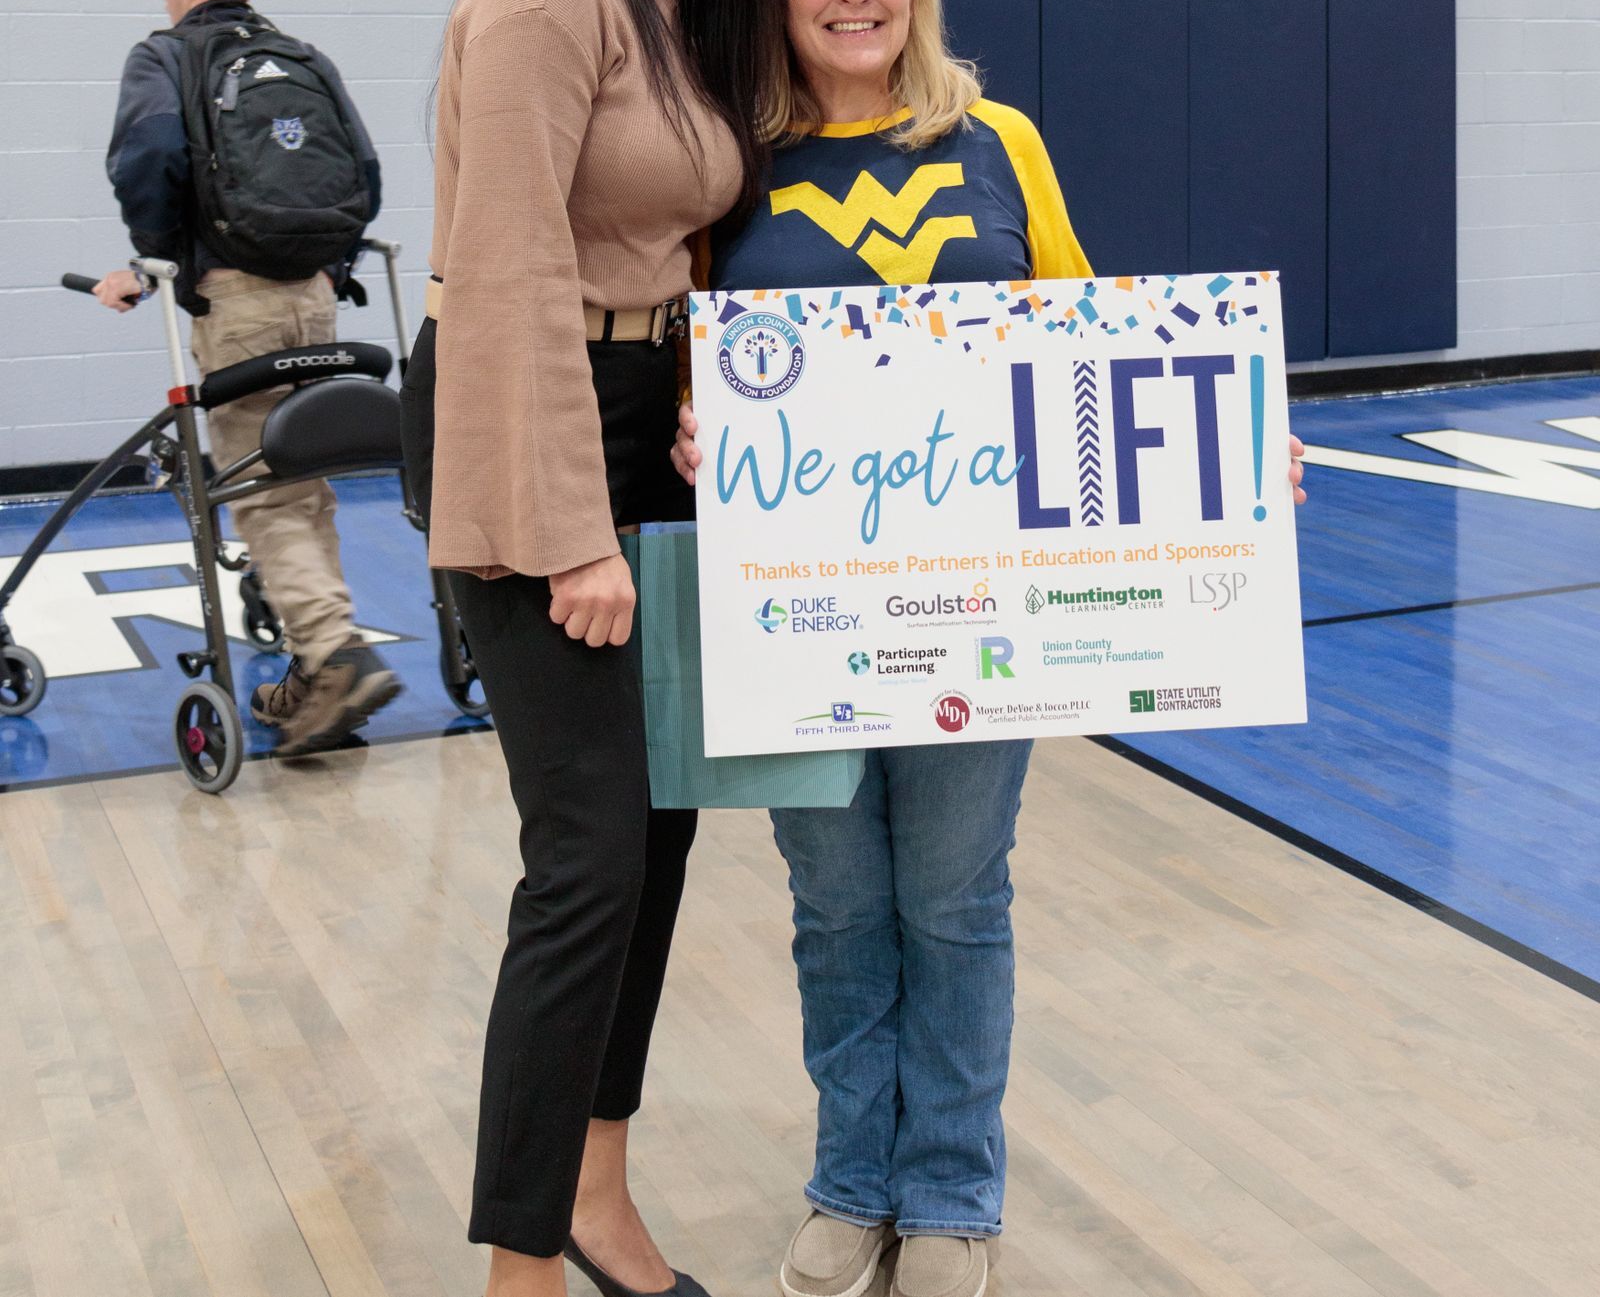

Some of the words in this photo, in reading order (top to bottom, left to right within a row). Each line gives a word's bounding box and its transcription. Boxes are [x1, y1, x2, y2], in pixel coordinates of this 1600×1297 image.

[726, 317, 754, 340] UNION
[757, 316, 795, 337] COUNTY
[274, 350, 355, 370] crocodile
[720, 356, 758, 397] EDUCATION
[762, 353, 802, 397] FOUNDATION
[716, 408, 835, 511] We
[852, 408, 958, 545] got
[968, 444, 1026, 487] a
[1010, 354, 1267, 531] LIFT!
[740, 561, 811, 580] Thanks
[818, 560, 838, 577] to
[845, 558, 899, 576] these
[906, 555, 989, 573] Partners
[997, 551, 1013, 568] in
[1021, 547, 1116, 567] Education
[1123, 544, 1158, 562] and
[1165, 542, 1256, 564] Sponsors:
[1047, 586, 1162, 606] Huntington
[791, 596, 837, 614] DUKE
[886, 594, 997, 617] Goulston
[1064, 604, 1116, 613] LEARNING
[1128, 601, 1164, 610] CENTER
[792, 615, 860, 633] ENERGY
[929, 620, 962, 628] Modification
[963, 618, 997, 626] Technologies
[1042, 640, 1072, 652] Union
[1075, 638, 1112, 651] County
[877, 647, 947, 661] Participate
[1043, 653, 1103, 666] Community
[1106, 649, 1164, 663] Foundation
[877, 662, 935, 675] Learning
[1156, 688, 1184, 700] STATE
[1187, 686, 1221, 698] UTILITY
[1007, 704, 1034, 714] DeVoe
[1036, 703, 1042, 712] &
[1070, 700, 1091, 710] PLLC
[1157, 699, 1222, 711] CONTRACTORS
[936, 700, 967, 728] MDI
[988, 714, 1016, 723] Certified
[1018, 712, 1037, 722] Public
[1040, 711, 1080, 721] Accountants
[795, 727, 823, 736] FIFTH
[827, 725, 859, 734] THIRD
[863, 723, 892, 732] BANK
